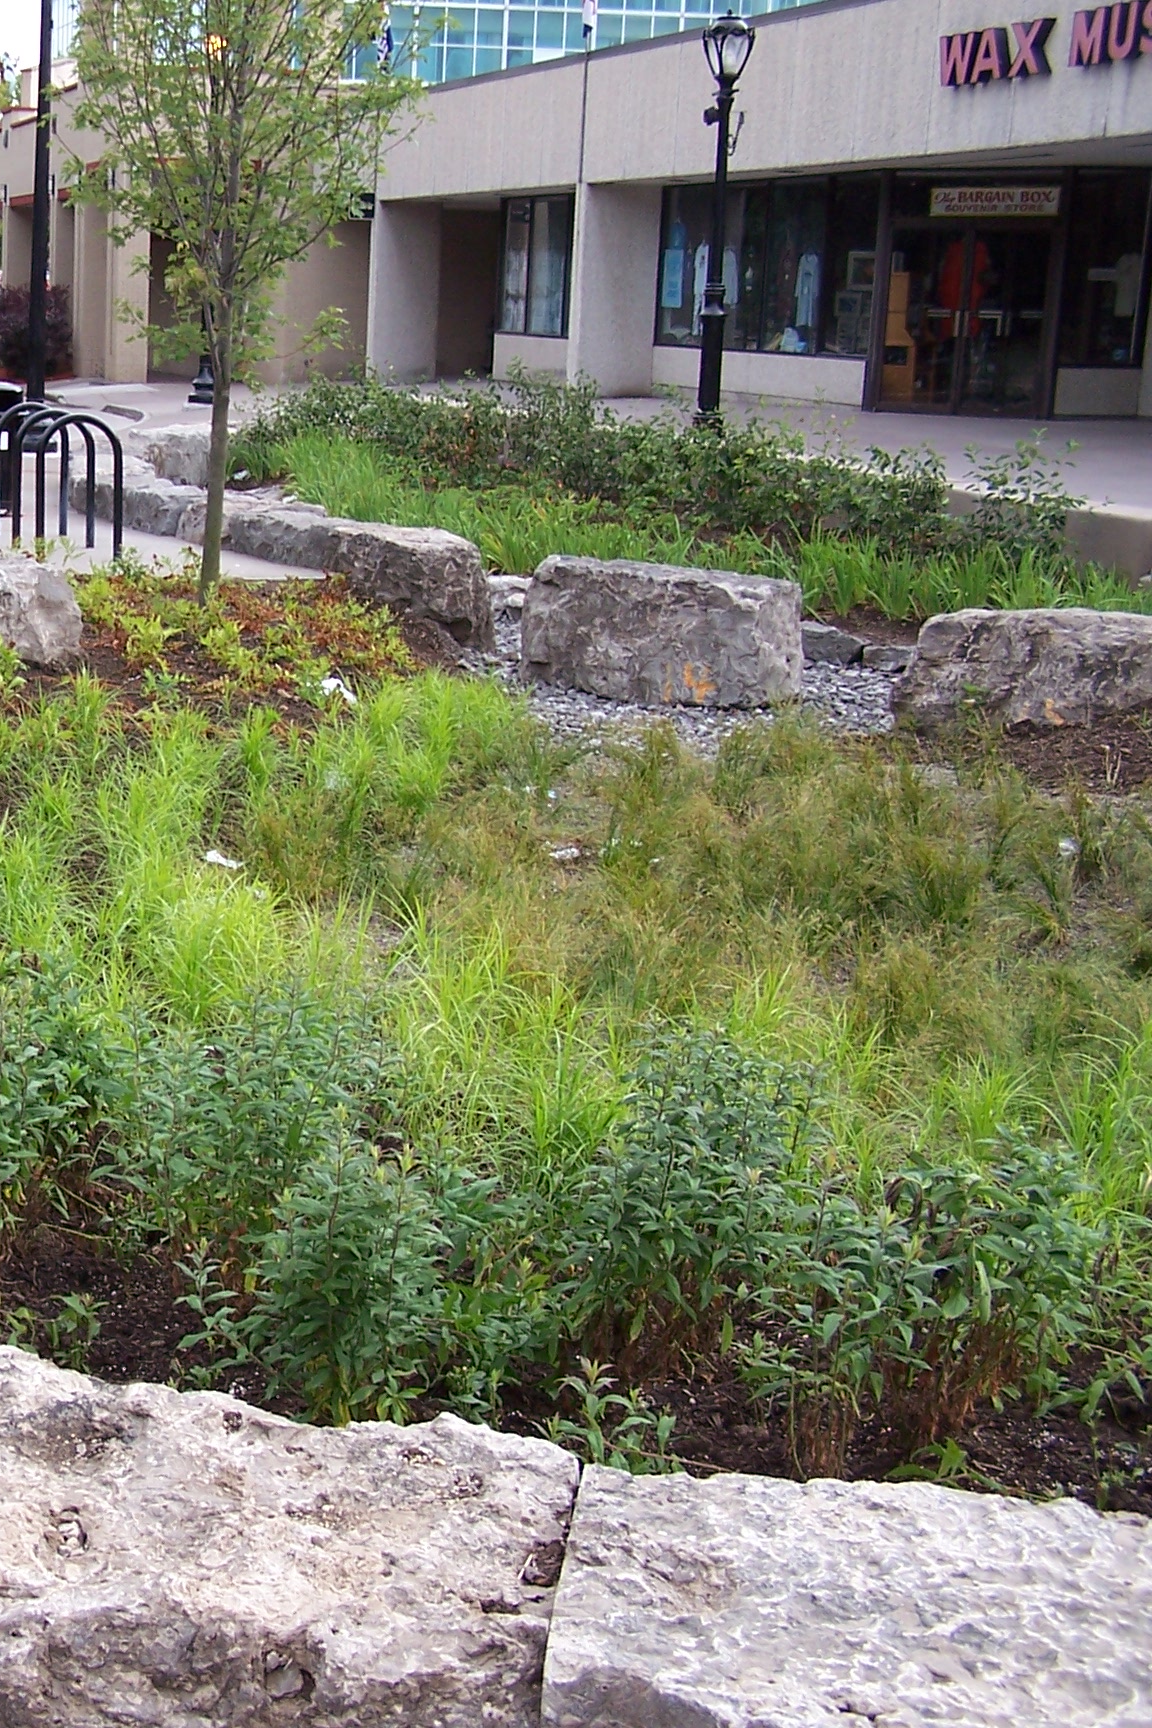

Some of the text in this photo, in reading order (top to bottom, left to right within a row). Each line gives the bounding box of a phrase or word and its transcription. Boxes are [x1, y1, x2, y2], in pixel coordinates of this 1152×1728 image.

[940, 18, 1055, 86] WAX
[957, 190, 1014, 203] BARGAIN
[1020, 190, 1054, 203] BOX
[945, 204, 1044, 212] SOUVENIR STORE
